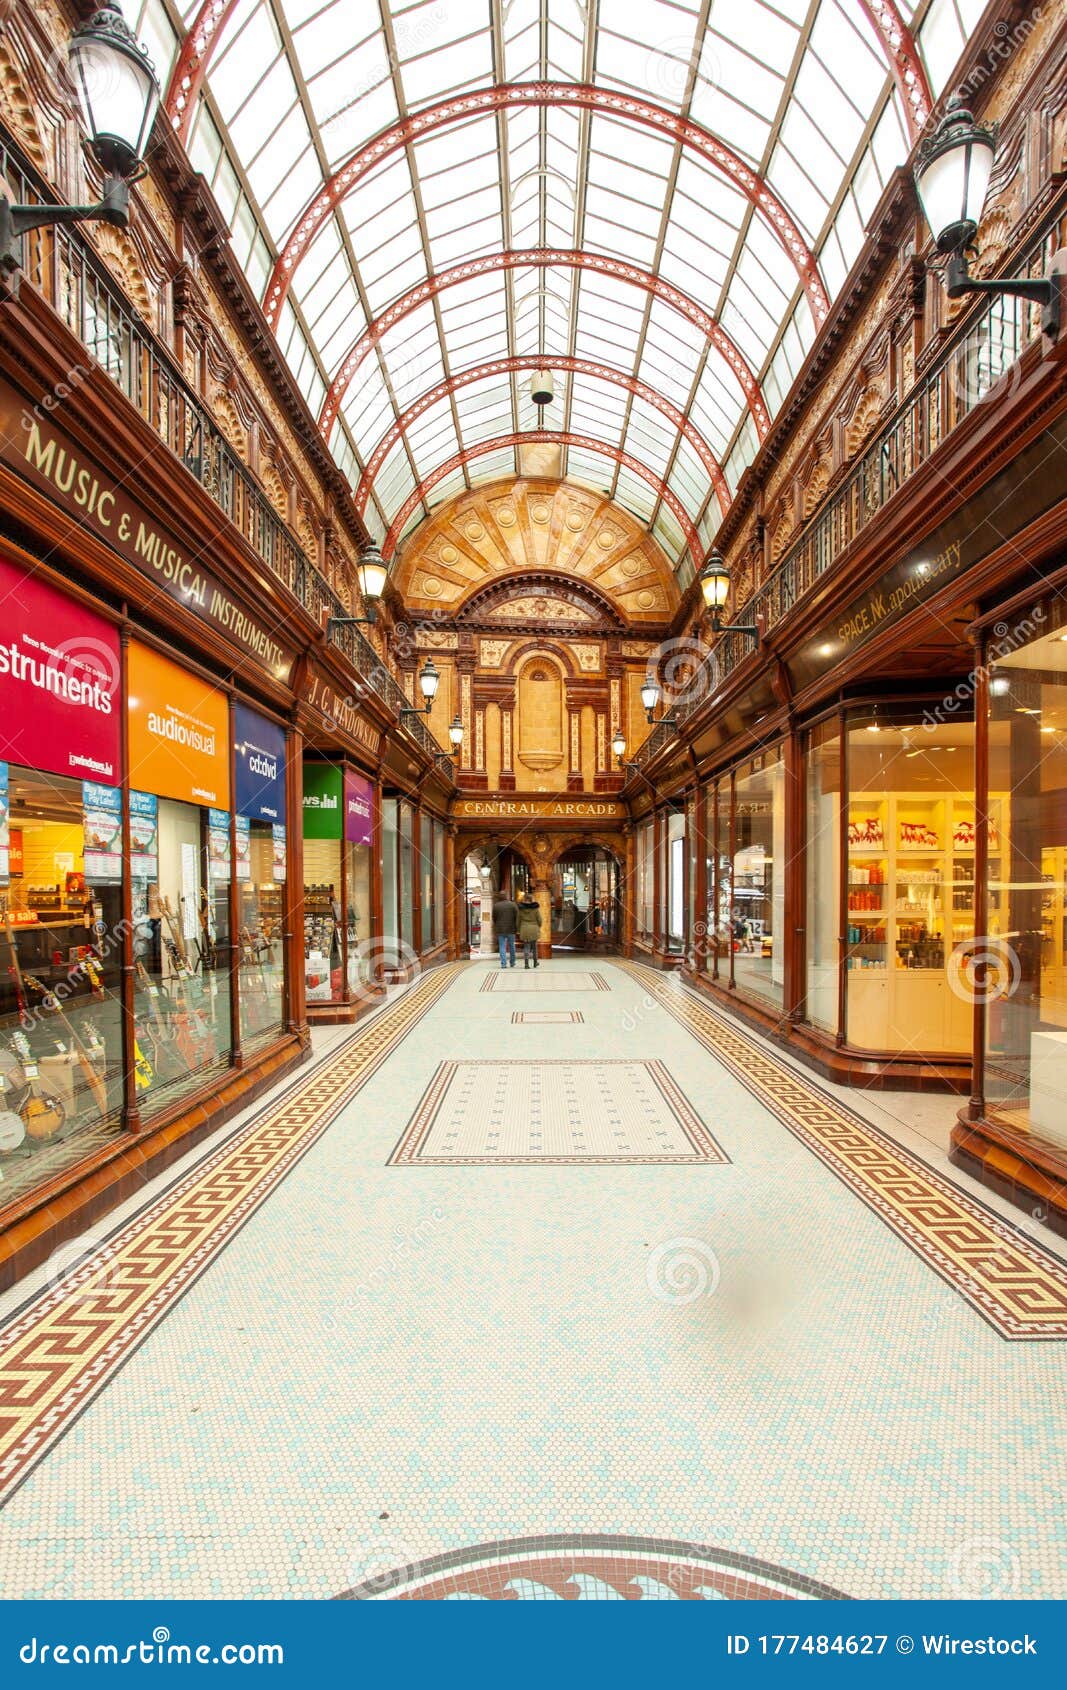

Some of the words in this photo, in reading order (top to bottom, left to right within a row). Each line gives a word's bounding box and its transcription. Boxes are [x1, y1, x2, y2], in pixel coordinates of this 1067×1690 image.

[25, 423, 116, 526] MUSIC
[118, 513, 131, 541] &
[135, 522, 208, 607] MUSICAL
[210, 589, 283, 667] INSTRUMENTS
[0, 643, 112, 714] struments
[148, 712, 215, 756] audiovisual
[249, 754, 277, 780] cd:dvd
[464, 801, 539, 814] CENTRAL
[553, 803, 617, 815] ARCADE
